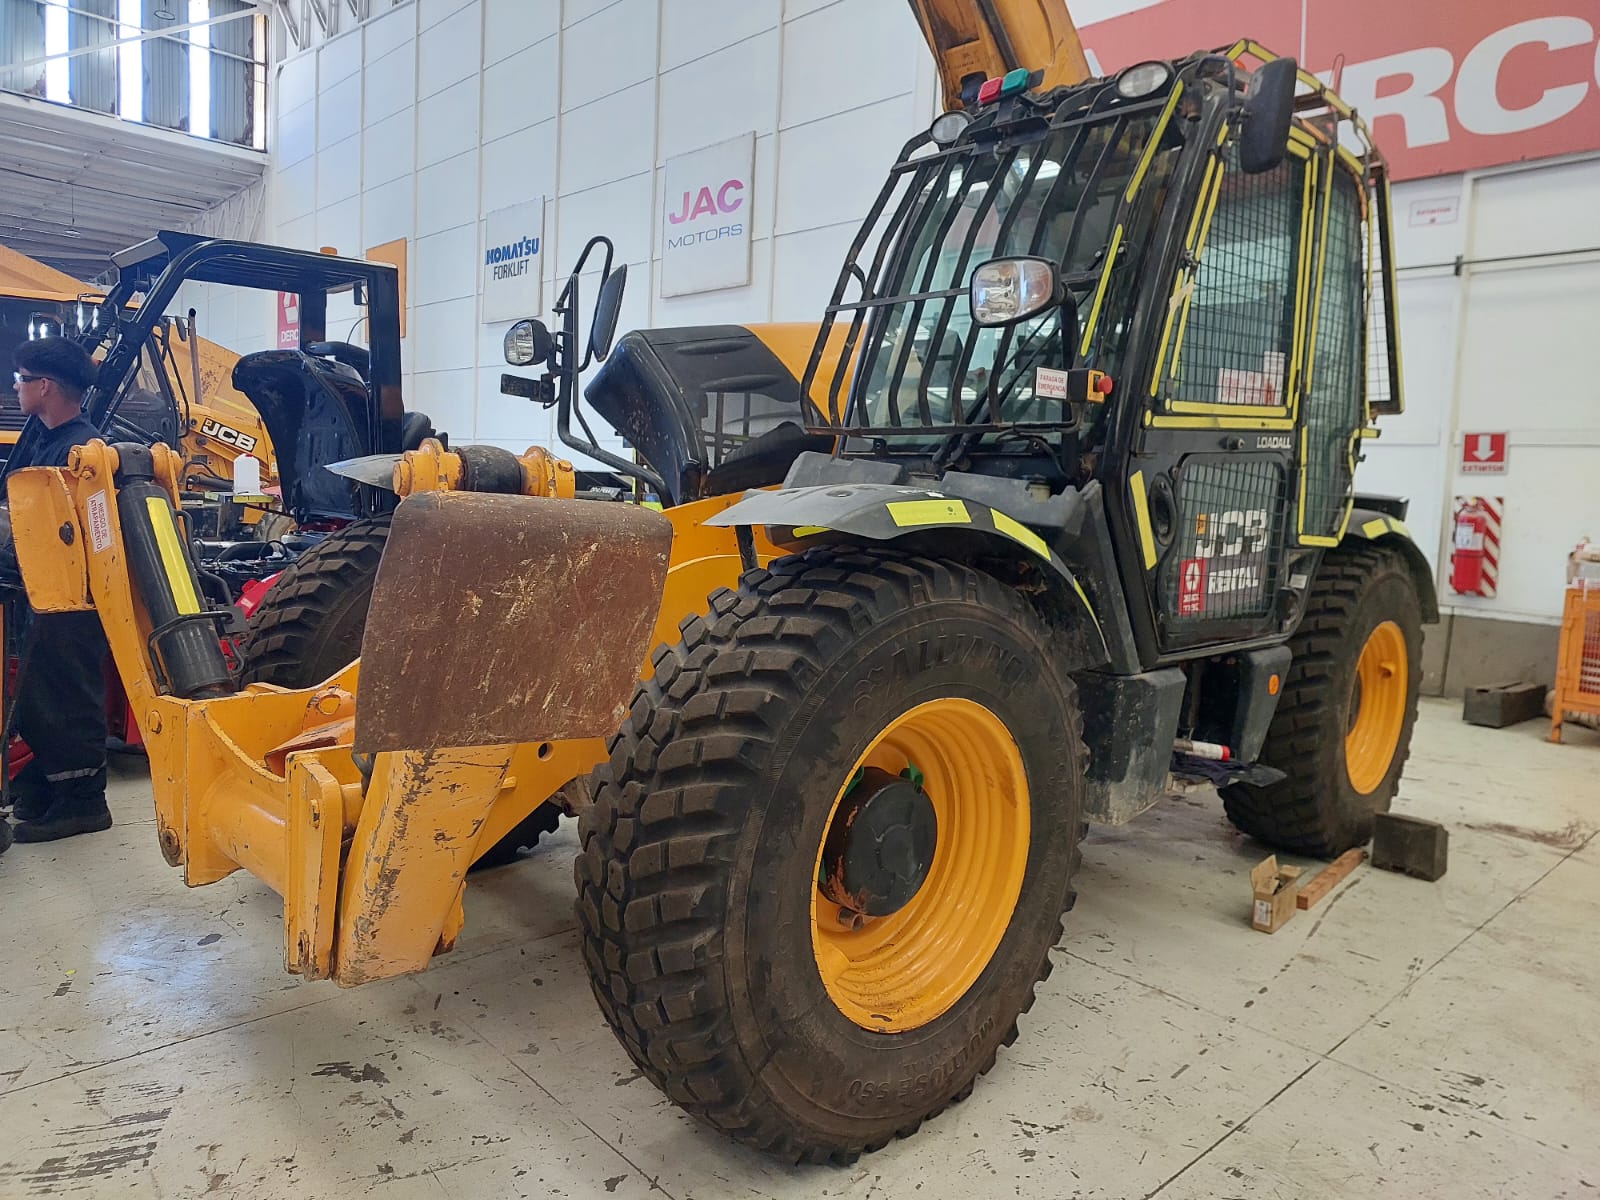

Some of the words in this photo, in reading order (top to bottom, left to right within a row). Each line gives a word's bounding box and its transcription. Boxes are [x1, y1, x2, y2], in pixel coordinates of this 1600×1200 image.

[668, 179, 744, 224] JAC
[668, 223, 742, 249] MOTORS
[486, 236, 539, 265] KOMATSU
[493, 259, 530, 280] FORKLIFT
[281, 329, 299, 342] DERC
[202, 418, 256, 451] JCB
[1256, 436, 1291, 449] LOADALL
[90, 499, 103, 550] ATRAPAMIENTO
[98, 502, 106, 528] RIESGO
[101, 528, 108, 539] DE
[1194, 509, 1267, 558] JCB
